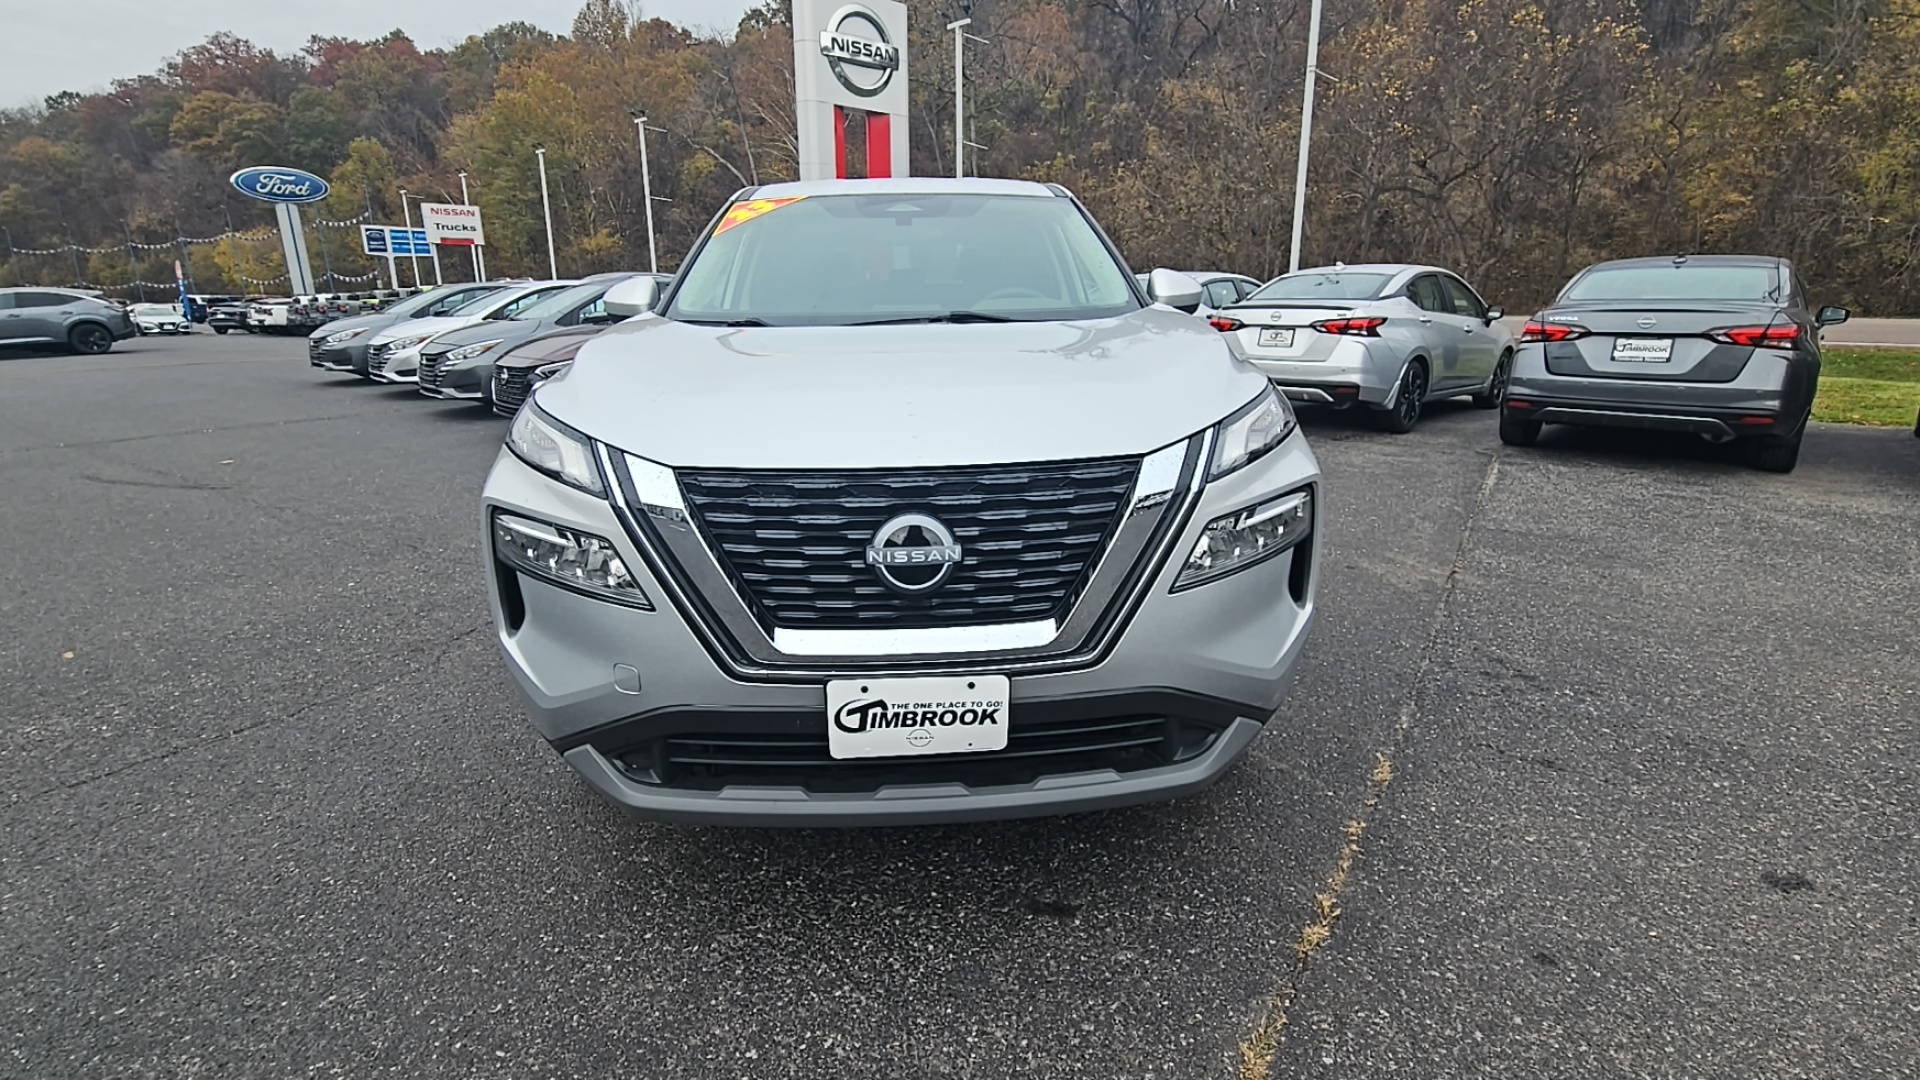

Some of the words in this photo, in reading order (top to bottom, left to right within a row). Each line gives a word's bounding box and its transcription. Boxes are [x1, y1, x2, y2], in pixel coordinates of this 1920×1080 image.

[831, 37, 894, 62] NISSAN
[255, 173, 310, 196] Ford
[430, 207, 475, 218] NISSAN
[434, 222, 477, 232] Trucks
[869, 549, 959, 562] NISSAN
[936, 701, 967, 709] PLACE
[986, 700, 1003, 708] GO!
[834, 699, 1001, 734] TIMBROOK
